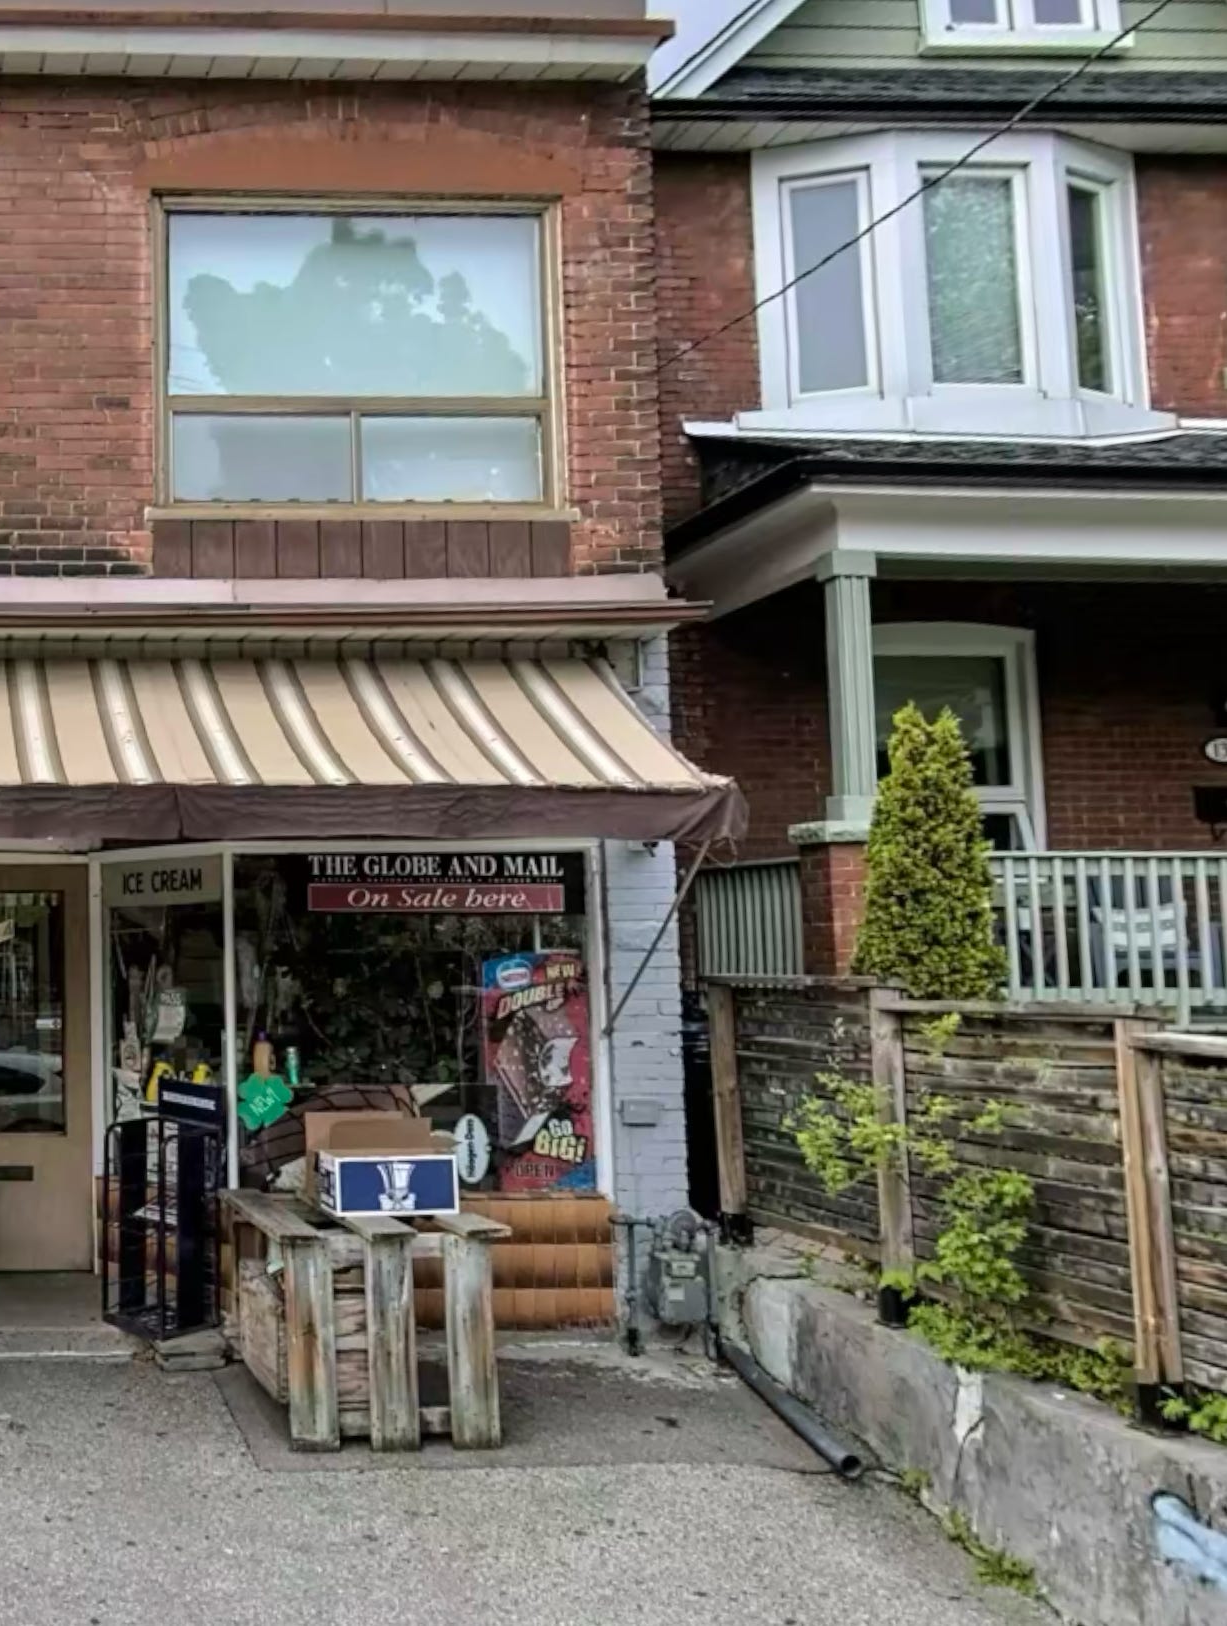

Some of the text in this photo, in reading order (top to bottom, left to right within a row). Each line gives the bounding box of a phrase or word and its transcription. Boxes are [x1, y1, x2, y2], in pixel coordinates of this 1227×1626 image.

[308, 855, 564, 877] THE GLOBE AND MAIL
[122, 868, 202, 895] ICE CREAM
[347, 888, 527, 908] On Sale here
[496, 982, 566, 1019] DOUBLE
[548, 1118, 574, 1138] GO
[533, 1127, 587, 1164] BIG!
